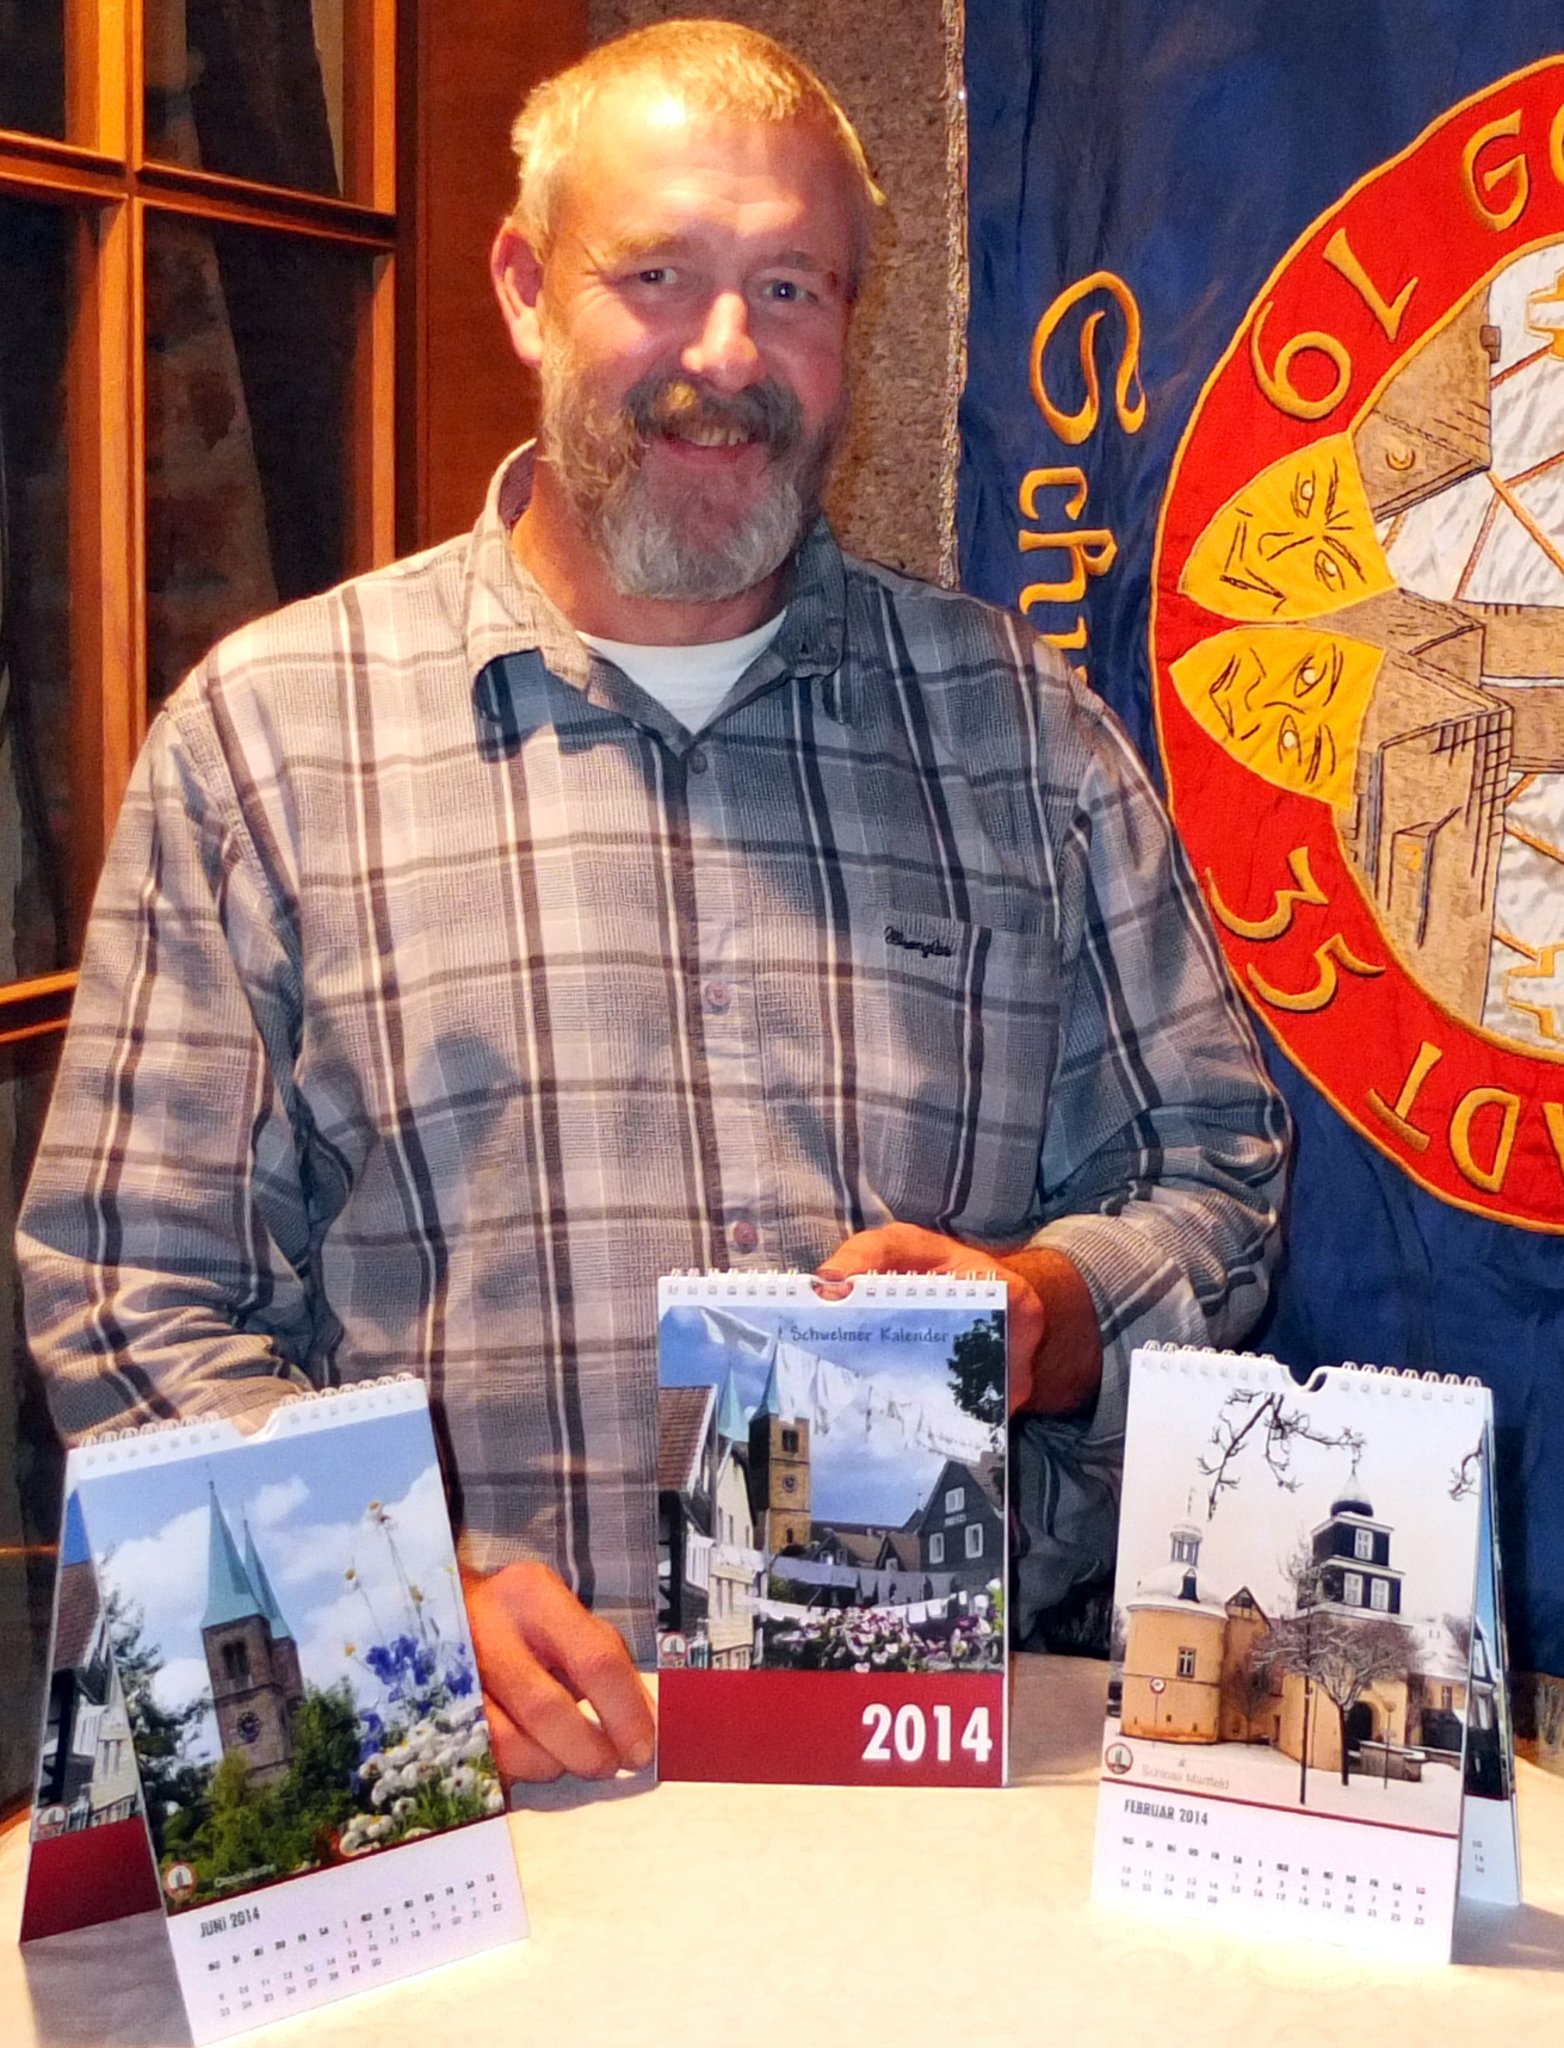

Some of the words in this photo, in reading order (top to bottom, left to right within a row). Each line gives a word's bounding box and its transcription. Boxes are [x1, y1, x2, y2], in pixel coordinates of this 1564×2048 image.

[1461, 100, 1564, 232] G
[790, 1325, 873, 1343] Schwelmer
[880, 1326, 950, 1344] Kalender
[861, 1703, 993, 1763] 2014
[1124, 1799, 1175, 1820] FEBRUAR
[1179, 1808, 1208, 1826] 2014
[200, 1916, 227, 1938] JUNI
[230, 1907, 260, 1928] 2014
